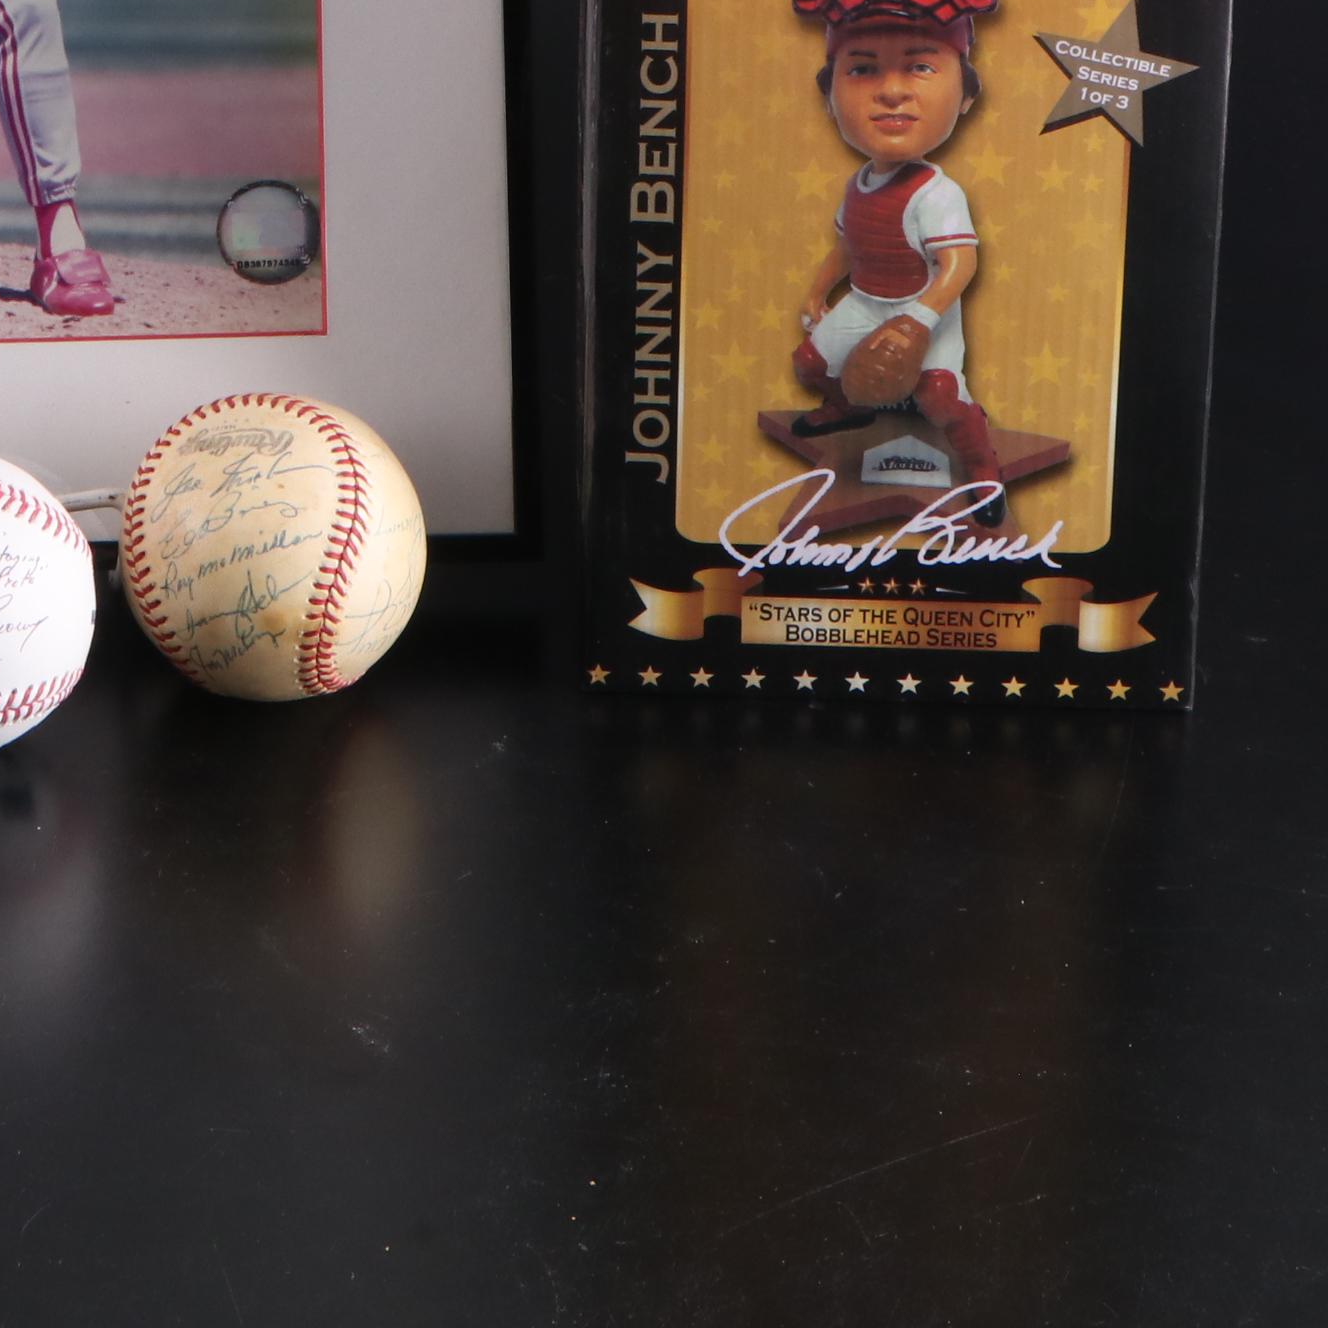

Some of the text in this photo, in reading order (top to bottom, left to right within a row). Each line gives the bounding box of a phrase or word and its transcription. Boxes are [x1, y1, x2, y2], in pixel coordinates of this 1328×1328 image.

[1055, 40, 1171, 78] COLLECTIBLE
[1077, 66, 1139, 91] SERIES
[1081, 87, 1129, 110] 1 OF 3
[625, 13, 679, 484] JOHNNY BENCH
[828, 608, 856, 624] OF
[859, 609, 897, 625] THE
[903, 607, 972, 628] QUEEN
[785, 624, 998, 648] BOBBLEHEAD SERIES
